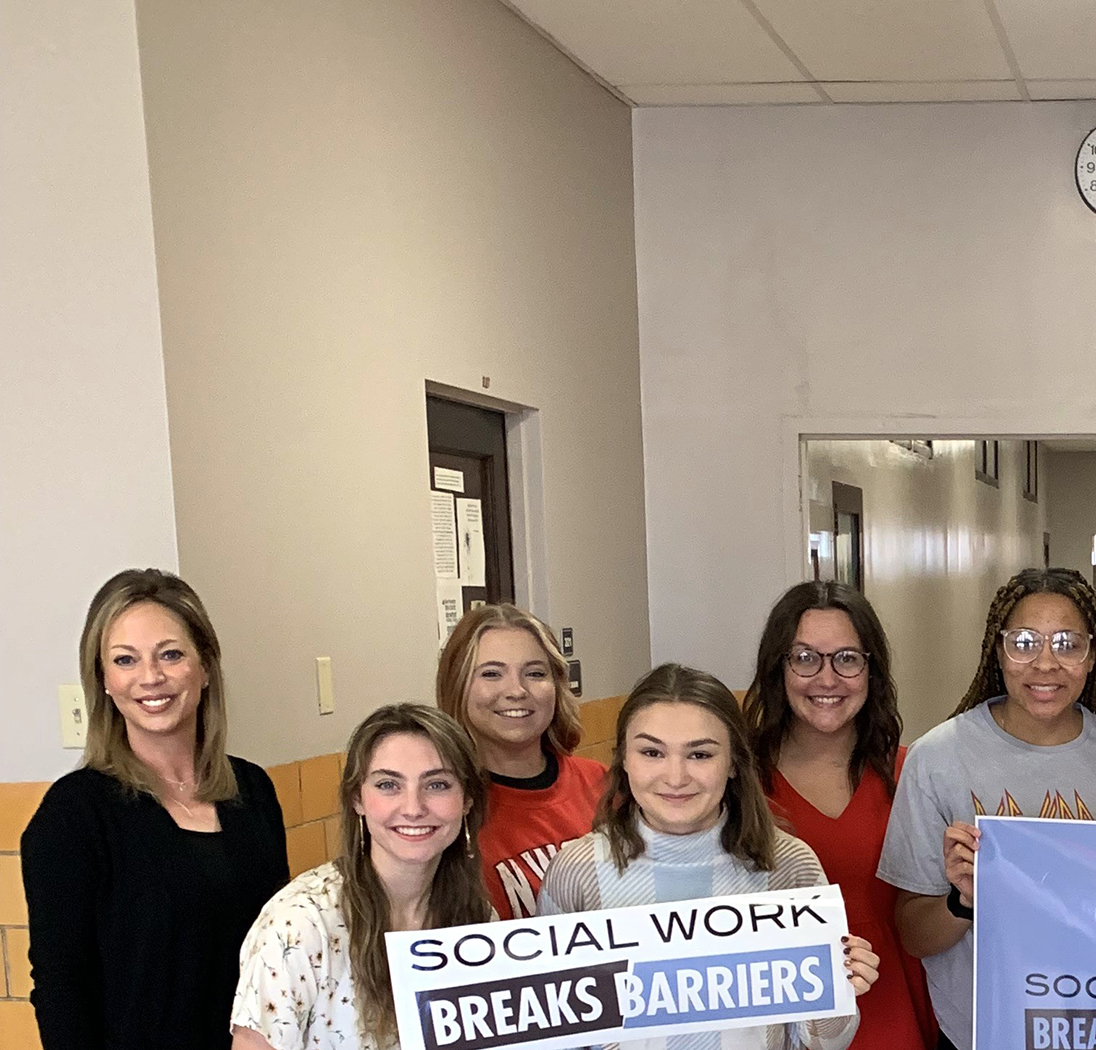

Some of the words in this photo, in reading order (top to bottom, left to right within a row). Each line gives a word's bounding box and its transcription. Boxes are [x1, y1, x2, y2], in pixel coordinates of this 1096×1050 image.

[1086, 161, 1096, 174] 9
[409, 918, 640, 972] SOCIAL
[649, 894, 828, 944] WORK
[429, 976, 604, 1047] BREAKS
[613, 956, 825, 1019] BARRIERS
